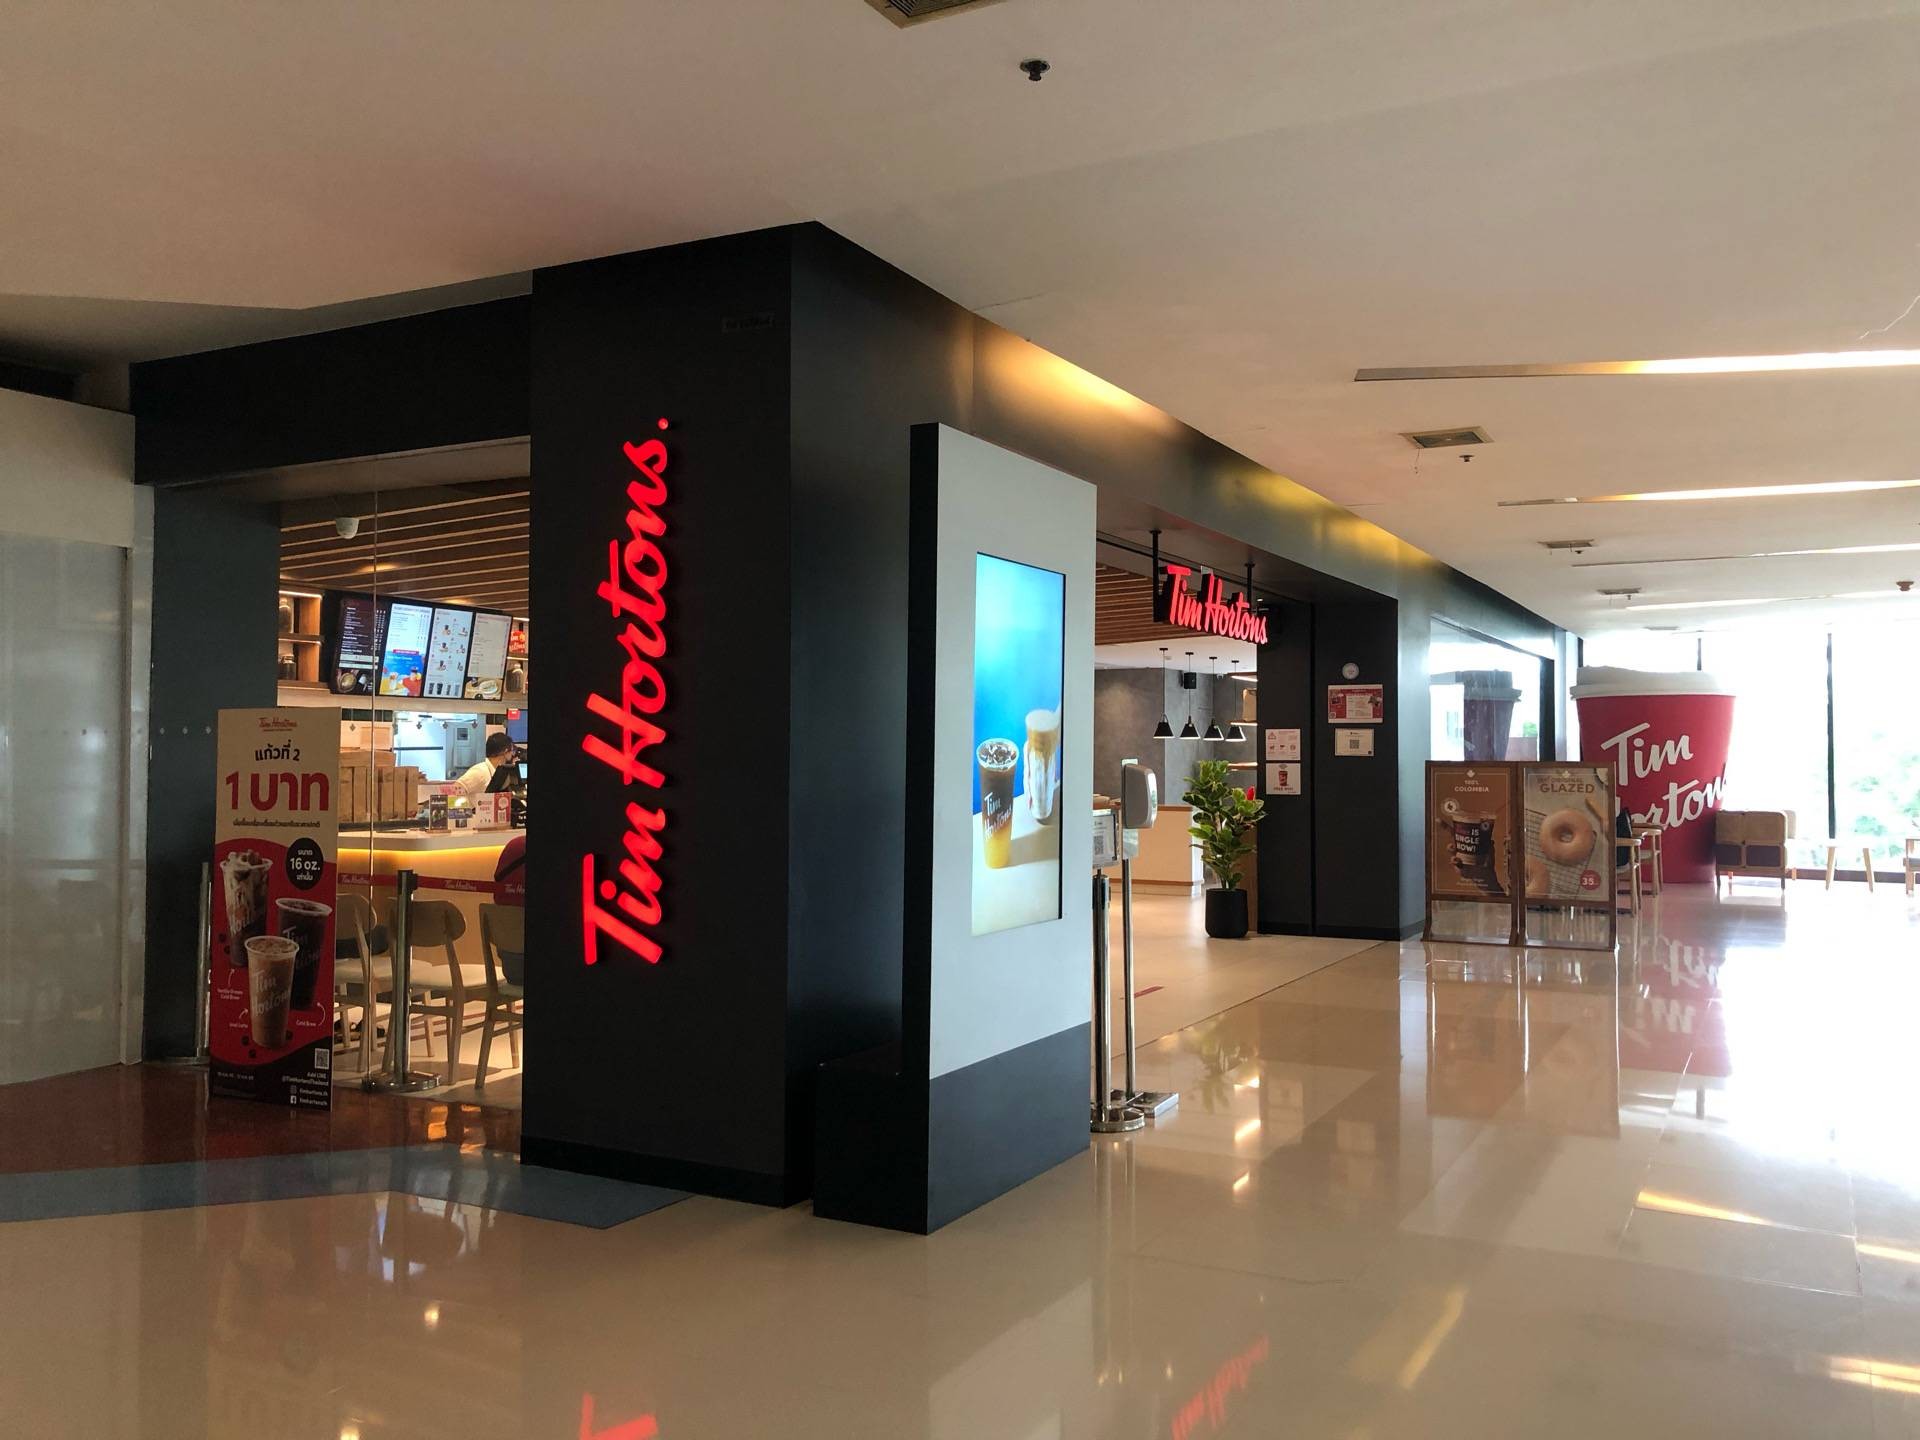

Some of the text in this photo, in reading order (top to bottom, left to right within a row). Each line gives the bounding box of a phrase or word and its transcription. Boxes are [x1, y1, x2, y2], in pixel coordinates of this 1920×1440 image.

[1167, 564, 1203, 631] Tim
[255, 739, 300, 761] แก้วที่ 2
[1600, 722, 1694, 786] Tim
[226, 771, 330, 811] 1 บาท
[1540, 783, 1595, 793] GLAZED
[984, 791, 1001, 817] Tim
[1471, 828, 1480, 836] IS
[290, 857, 321, 871] 16 oz.
[583, 802, 667, 965] Tim
